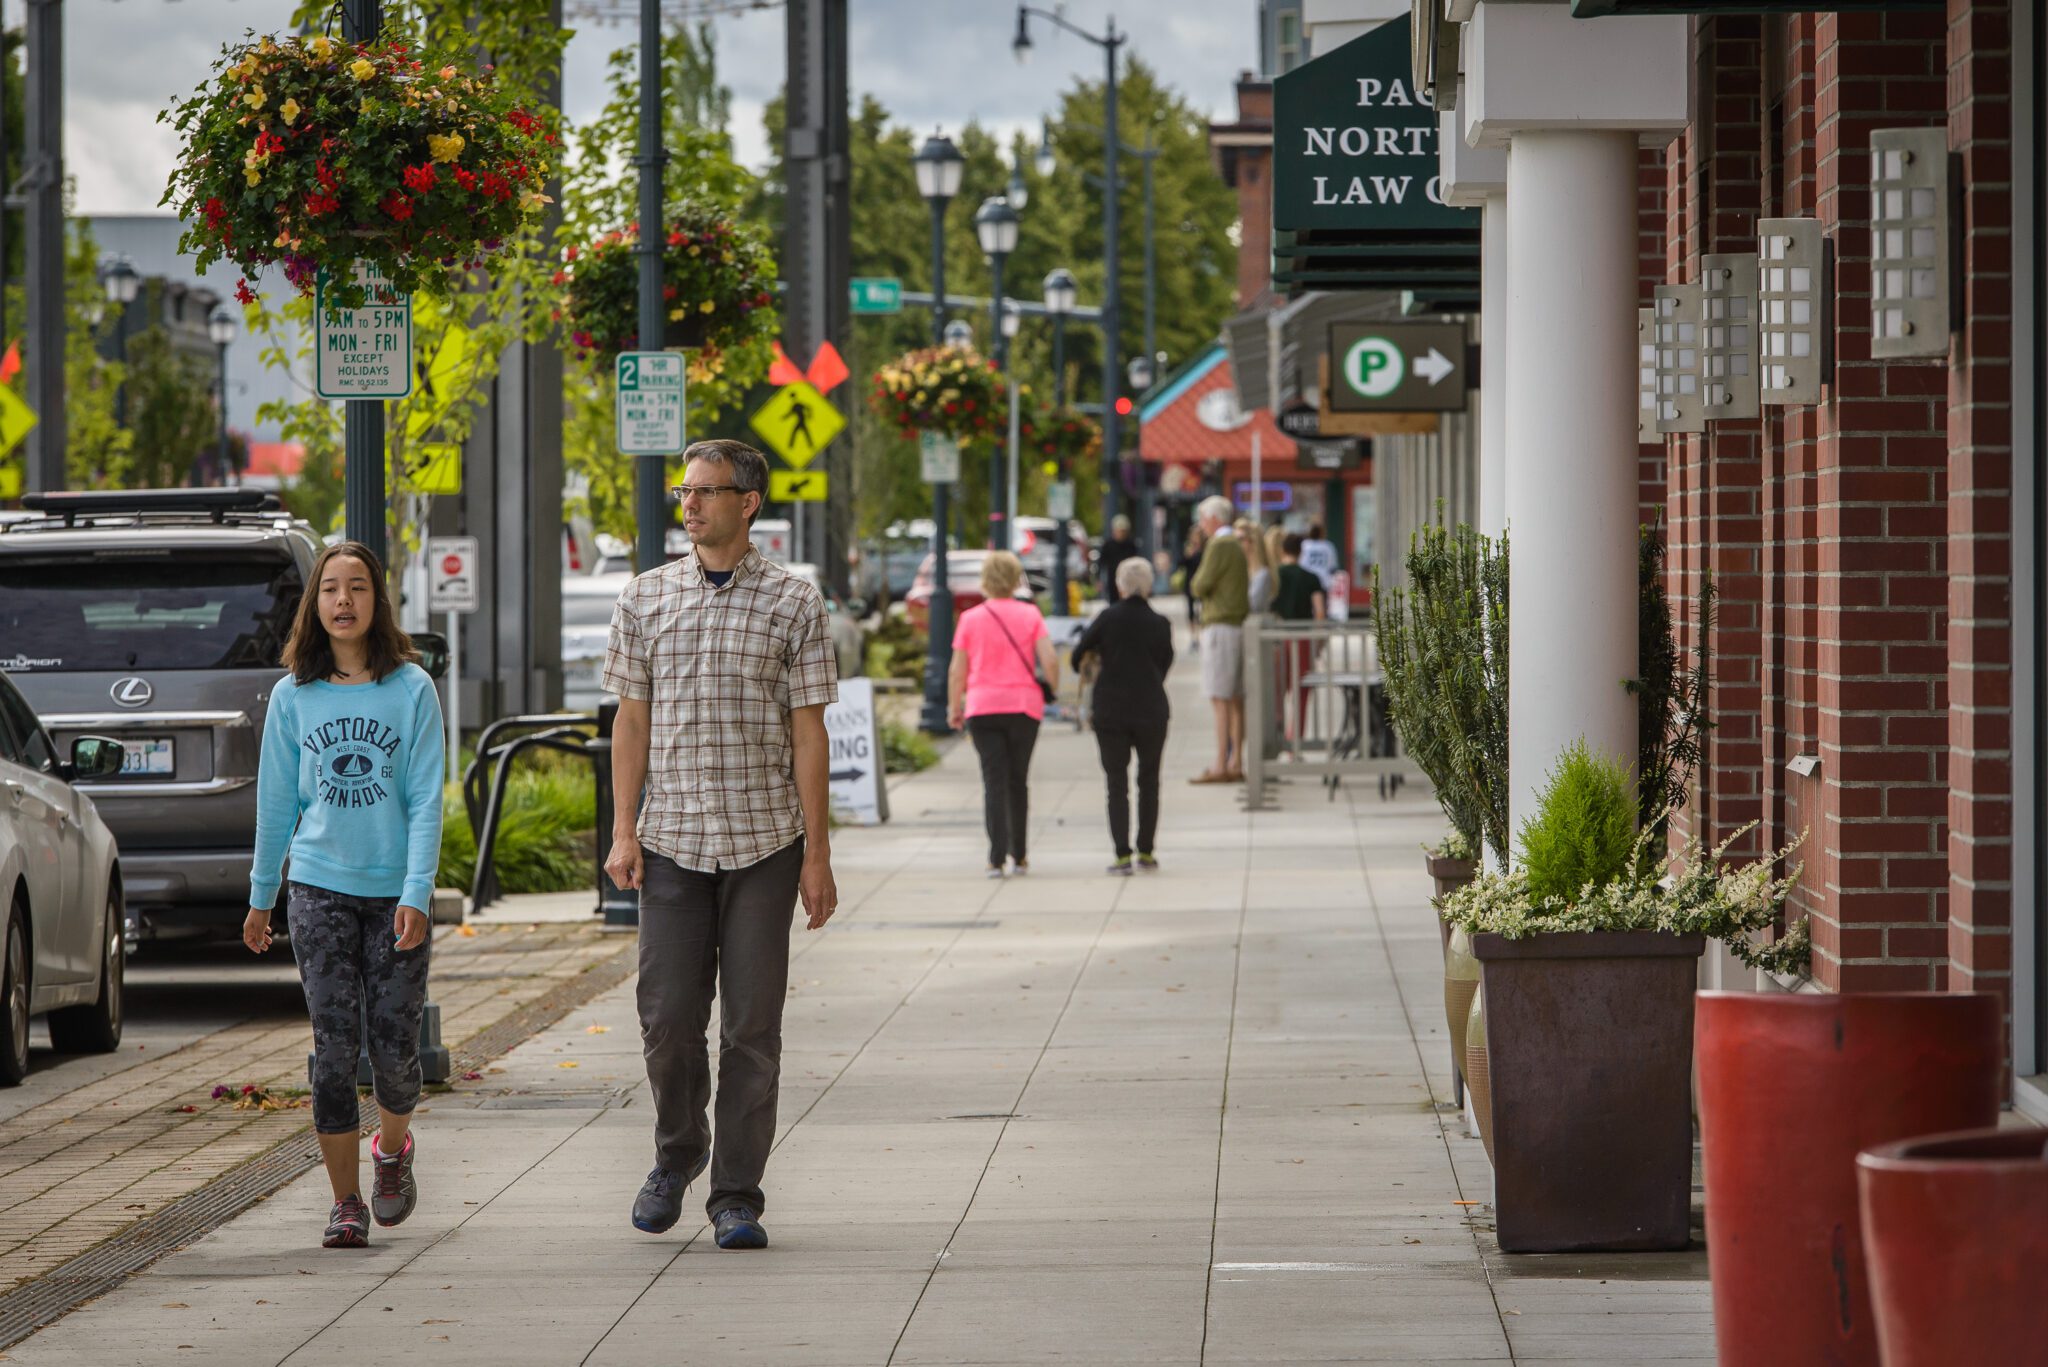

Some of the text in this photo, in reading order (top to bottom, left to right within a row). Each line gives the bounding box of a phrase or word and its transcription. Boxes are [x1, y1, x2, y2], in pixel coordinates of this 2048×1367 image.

[1313, 175, 1413, 205] LAW
[324, 310, 403, 328] 9AM TO 5PM
[328, 334, 357, 351] MON
[375, 334, 397, 351] FRI
[343, 354, 383, 363] EXCEPT
[1359, 350, 1388, 384] P
[337, 366, 389, 376] HOLIDAYS
[621, 360, 636, 386] 2
[641, 374, 681, 386] PARKING
[624, 393, 644, 405] 9AM
[658, 393, 678, 405] 5PM
[627, 409, 647, 421] MON
[658, 409, 675, 421] FRI
[303, 717, 401, 758] VICTORIA
[336, 745, 371, 753] WEST COAST
[319, 780, 388, 808] CANADA
